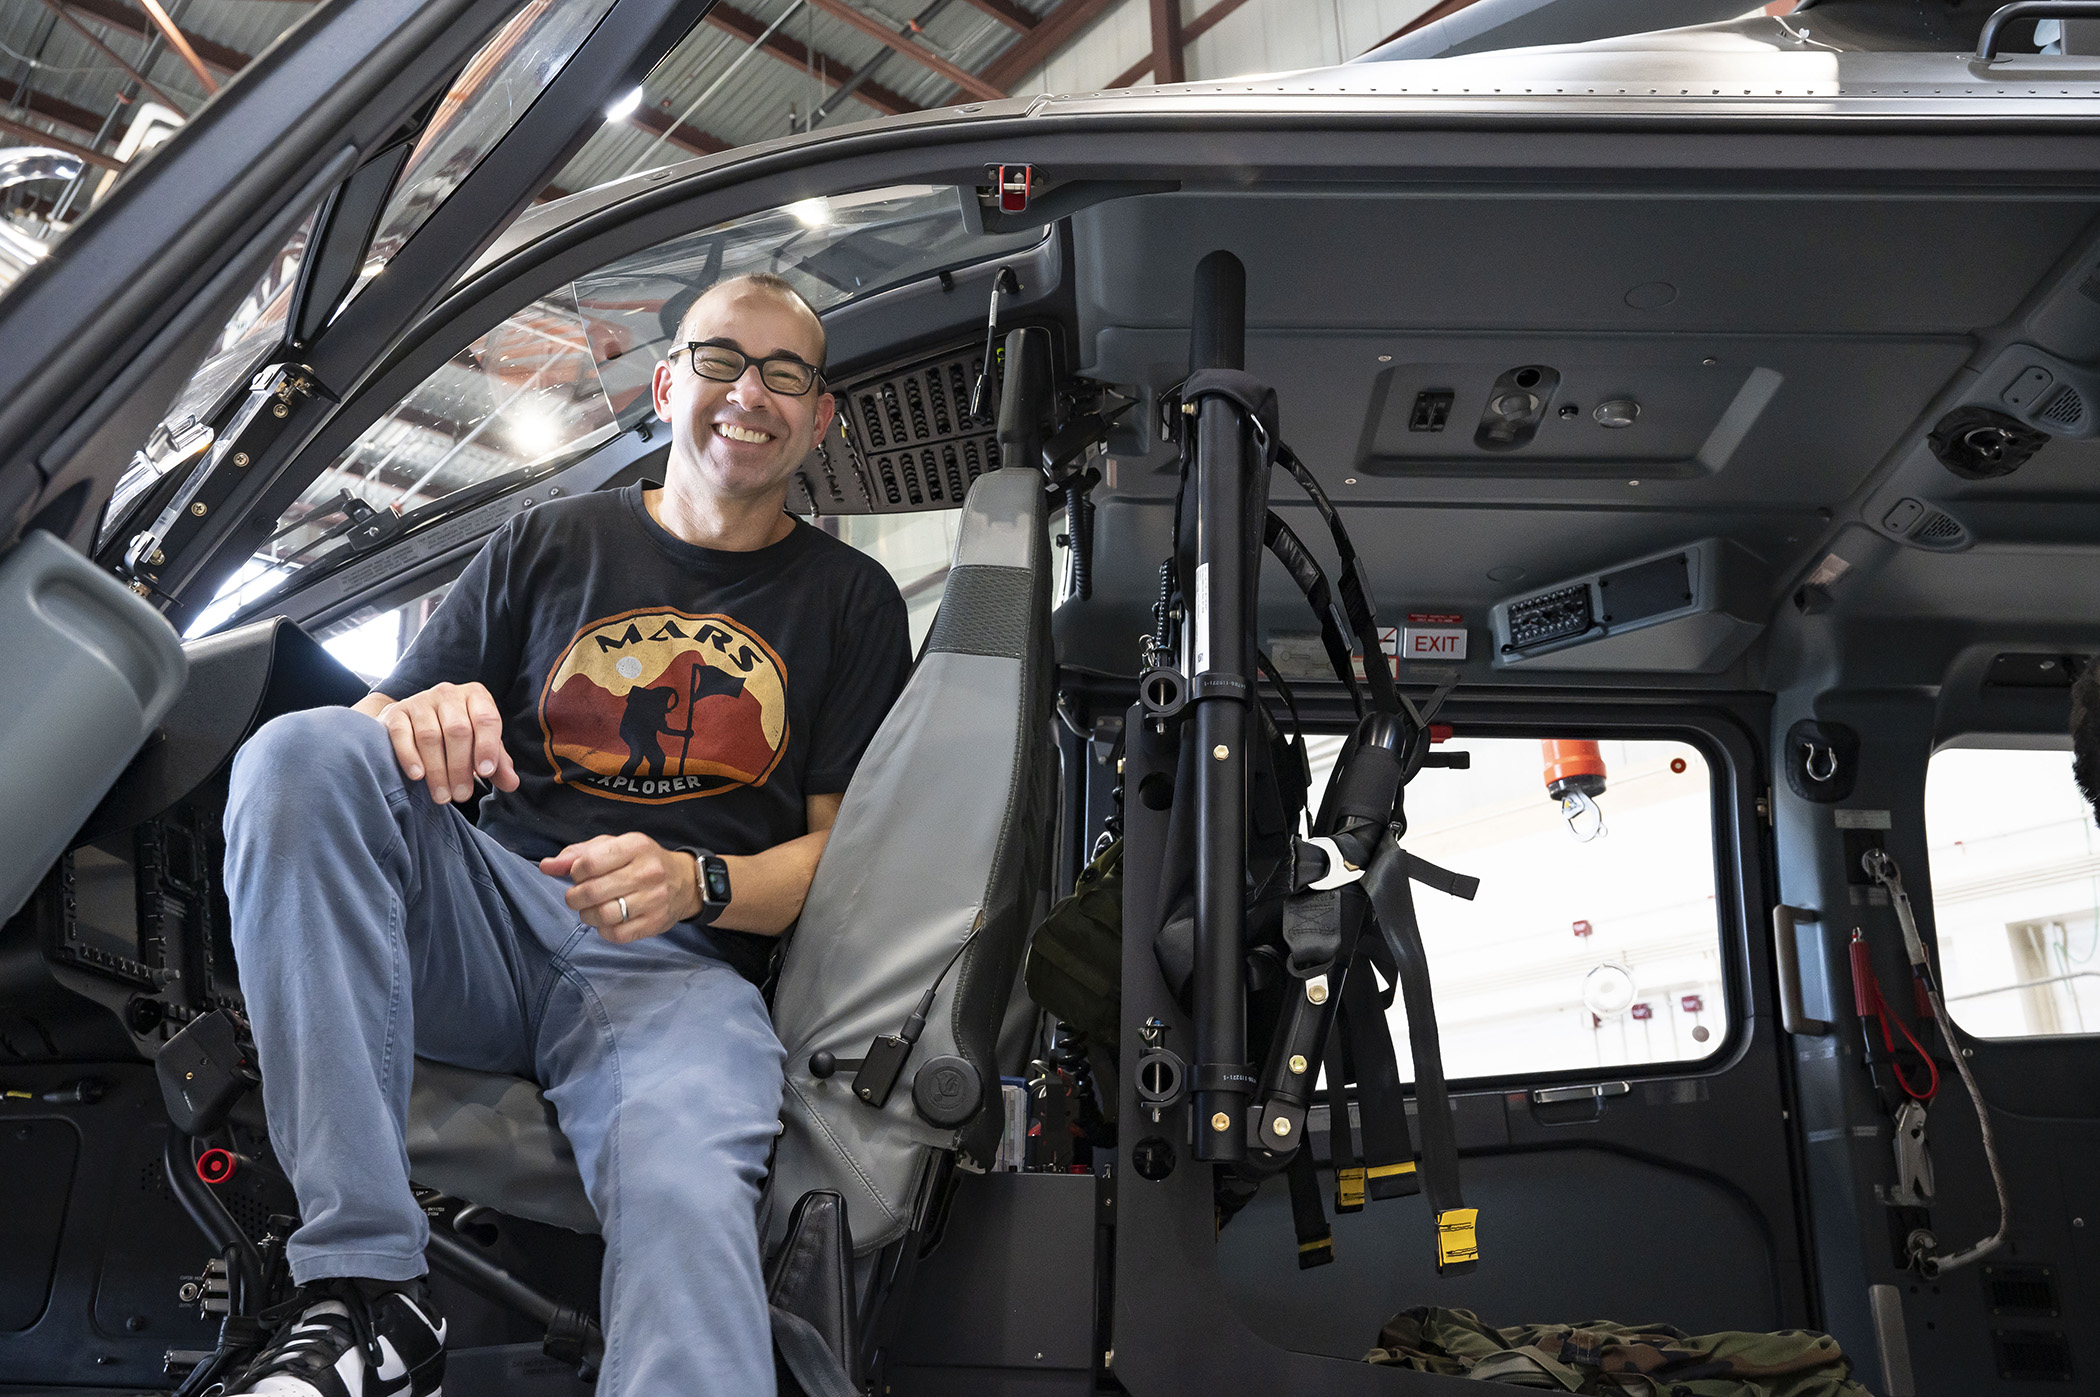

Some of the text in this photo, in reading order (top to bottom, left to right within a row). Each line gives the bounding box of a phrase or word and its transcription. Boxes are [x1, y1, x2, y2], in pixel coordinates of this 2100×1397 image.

[595, 620, 764, 672] MARS
[1415, 636, 1459, 652] EXIT
[588, 775, 702, 795] XPLORER
